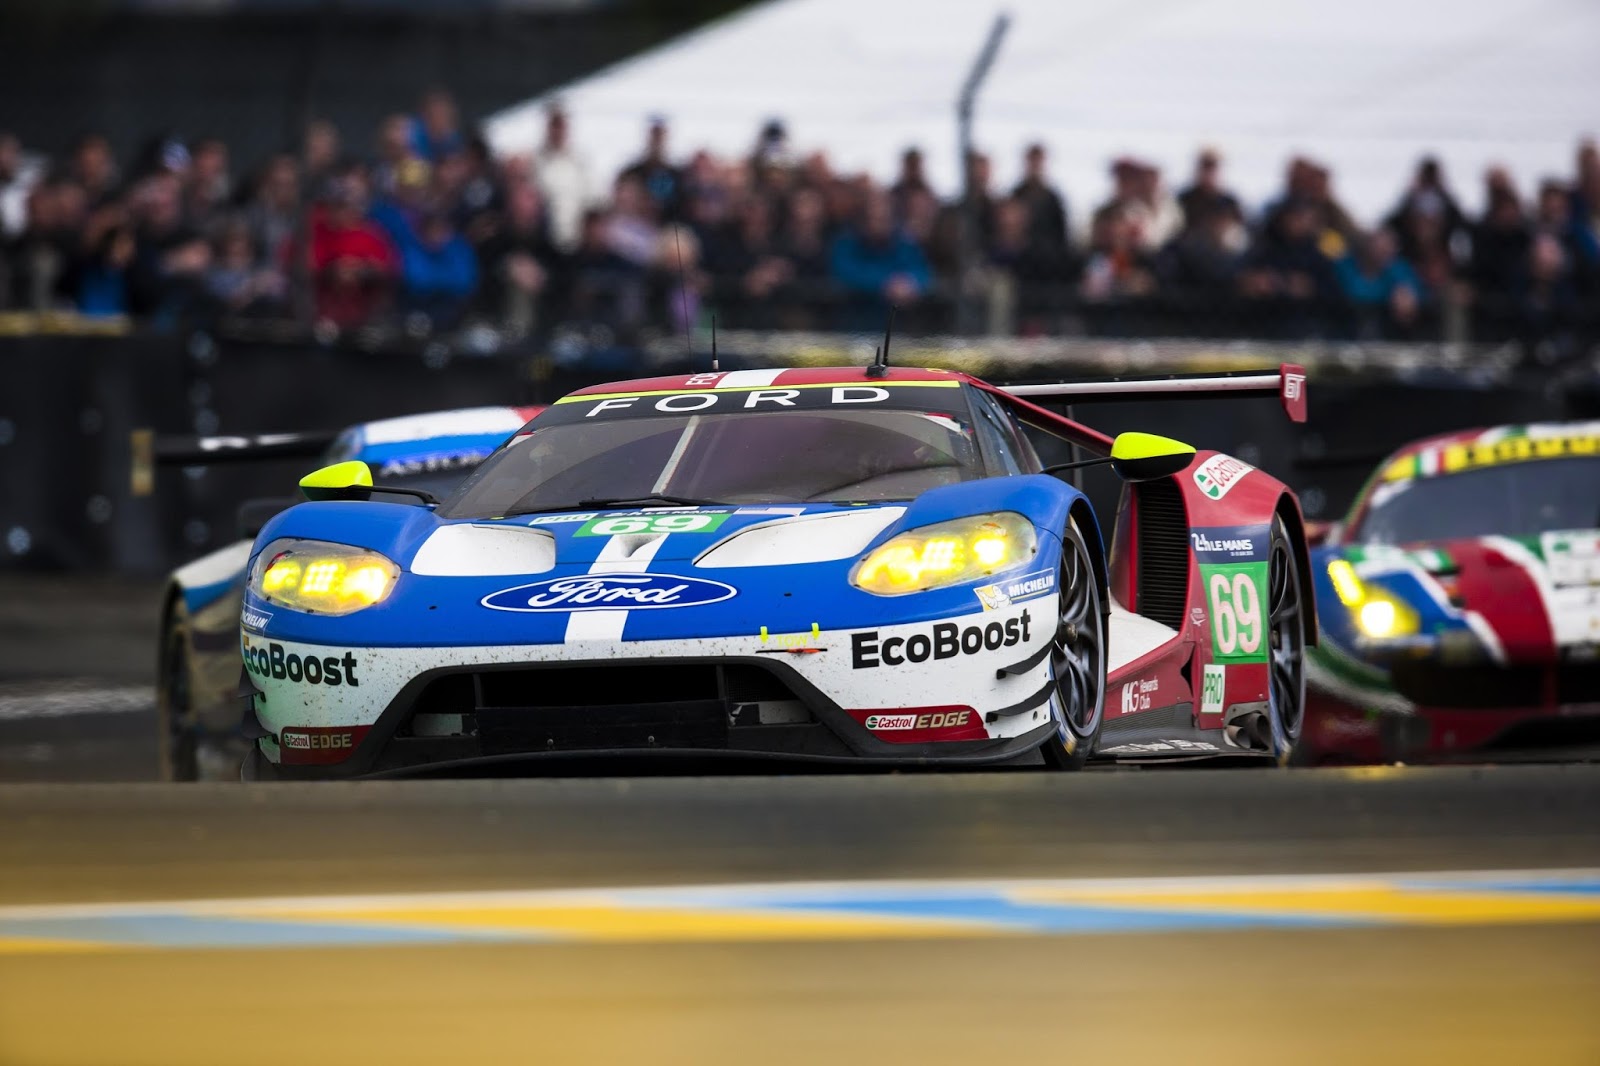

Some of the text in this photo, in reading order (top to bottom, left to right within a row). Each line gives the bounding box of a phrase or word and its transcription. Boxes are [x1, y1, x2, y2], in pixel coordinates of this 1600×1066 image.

[586, 387, 890, 418] FORD
[590, 514, 713, 535] 69
[528, 577, 689, 607] Ford
[1008, 575, 1054, 597] MICHELIN
[1210, 573, 1261, 654] 69
[776, 634, 809, 647] TOW
[851, 608, 1031, 669] EcoBoost
[242, 635, 359, 687] EcoBoost
[1204, 673, 1222, 704] PRO
[878, 711, 971, 729] Castrol EDGE
[310, 733, 352, 749] EDGE
